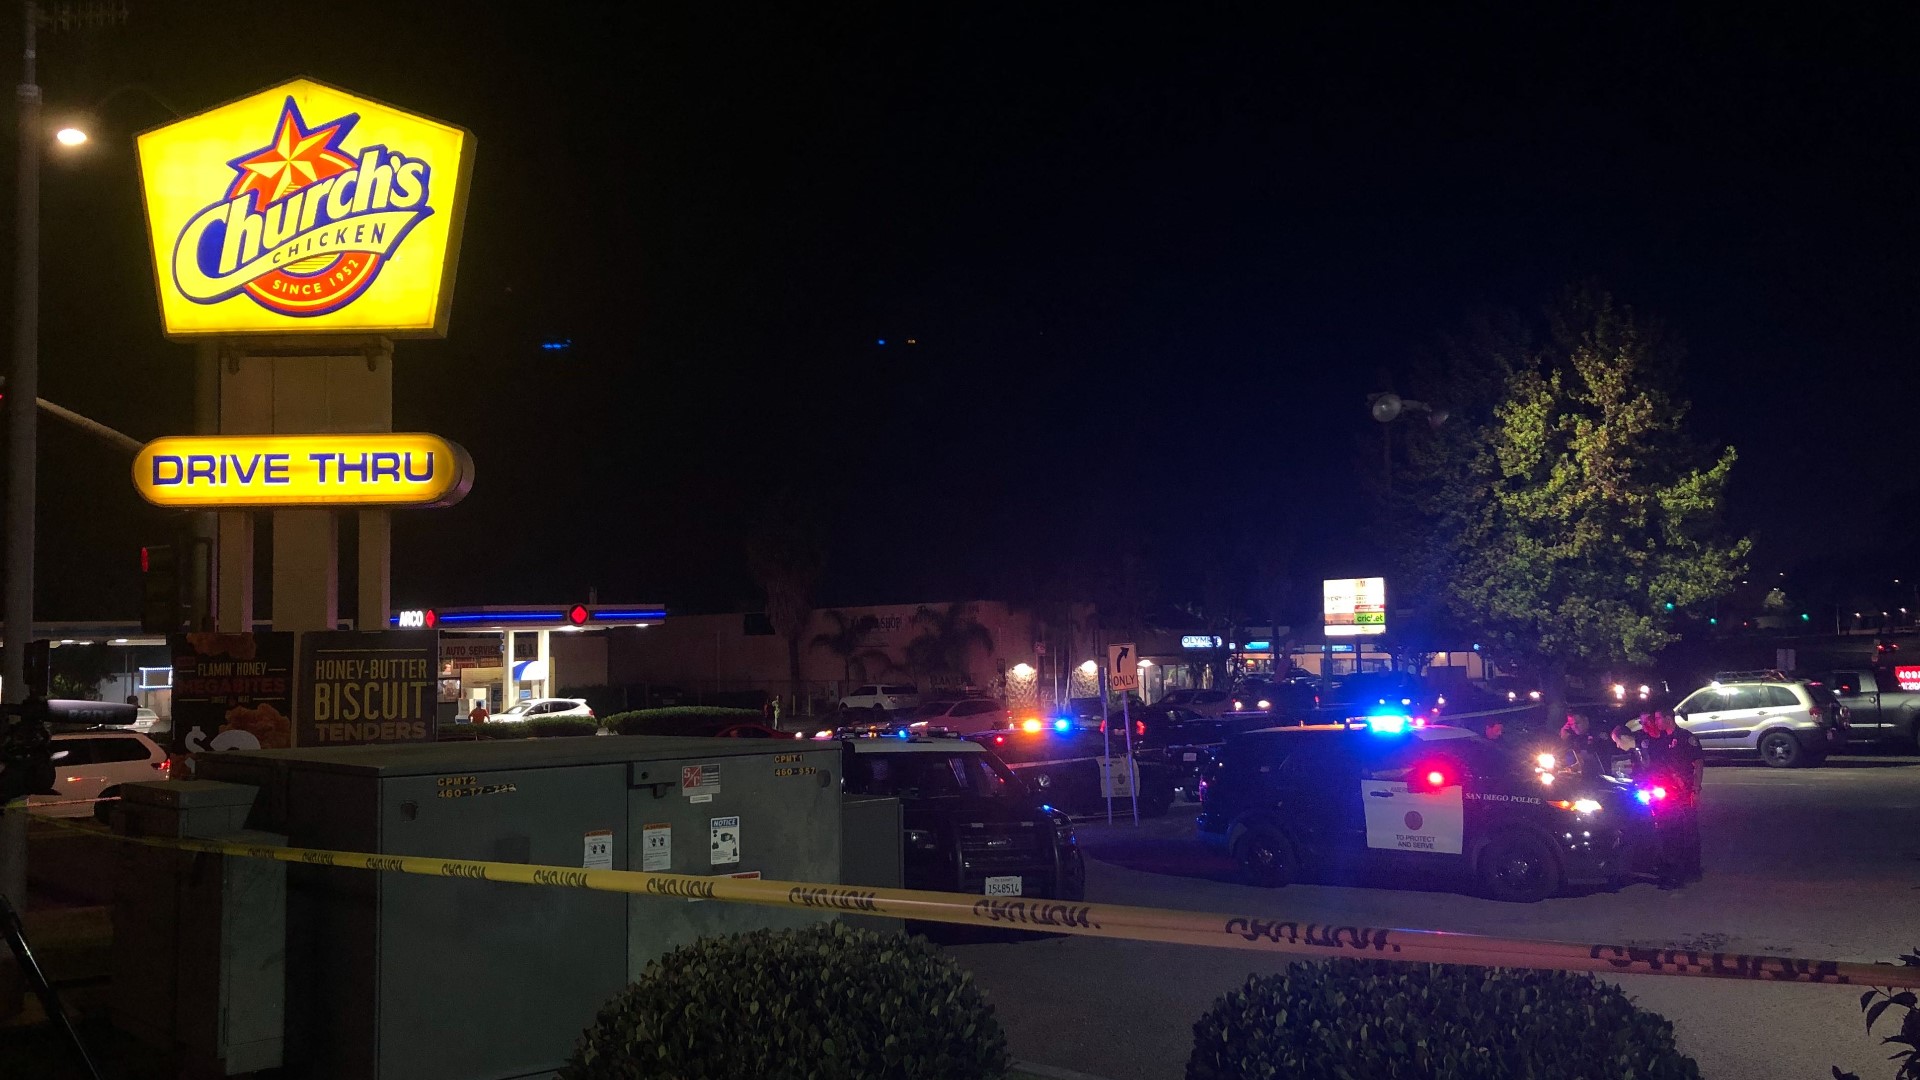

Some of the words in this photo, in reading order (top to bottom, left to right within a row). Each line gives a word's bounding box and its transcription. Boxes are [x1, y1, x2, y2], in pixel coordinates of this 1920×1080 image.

[173, 146, 430, 303] Church's
[272, 222, 387, 264] CHICKEN
[272, 278, 323, 295] SINCE
[330, 258, 360, 287] 1952
[152, 454, 290, 486] DRIVE
[309, 452, 434, 483] THRU
[399, 610, 424, 627] ARCO
[446, 646, 466, 656] AUTO
[197, 662, 234, 676] FLAMIN'
[236, 662, 267, 676] HONEY
[315, 659, 427, 680] HONEY-BUTTER
[176, 677, 287, 695] MEGABITES
[1113, 674, 1135, 687] ONLY
[314, 722, 427, 741] TENDERS
[1465, 792, 1481, 801] SAN
[1483, 793, 1509, 802] DIEGO
[1510, 795, 1542, 805] POLICE
[713, 818, 737, 827] NOTICE
[1406, 834, 1436, 843] PROTECT
[1413, 842, 1434, 850] SERVE
